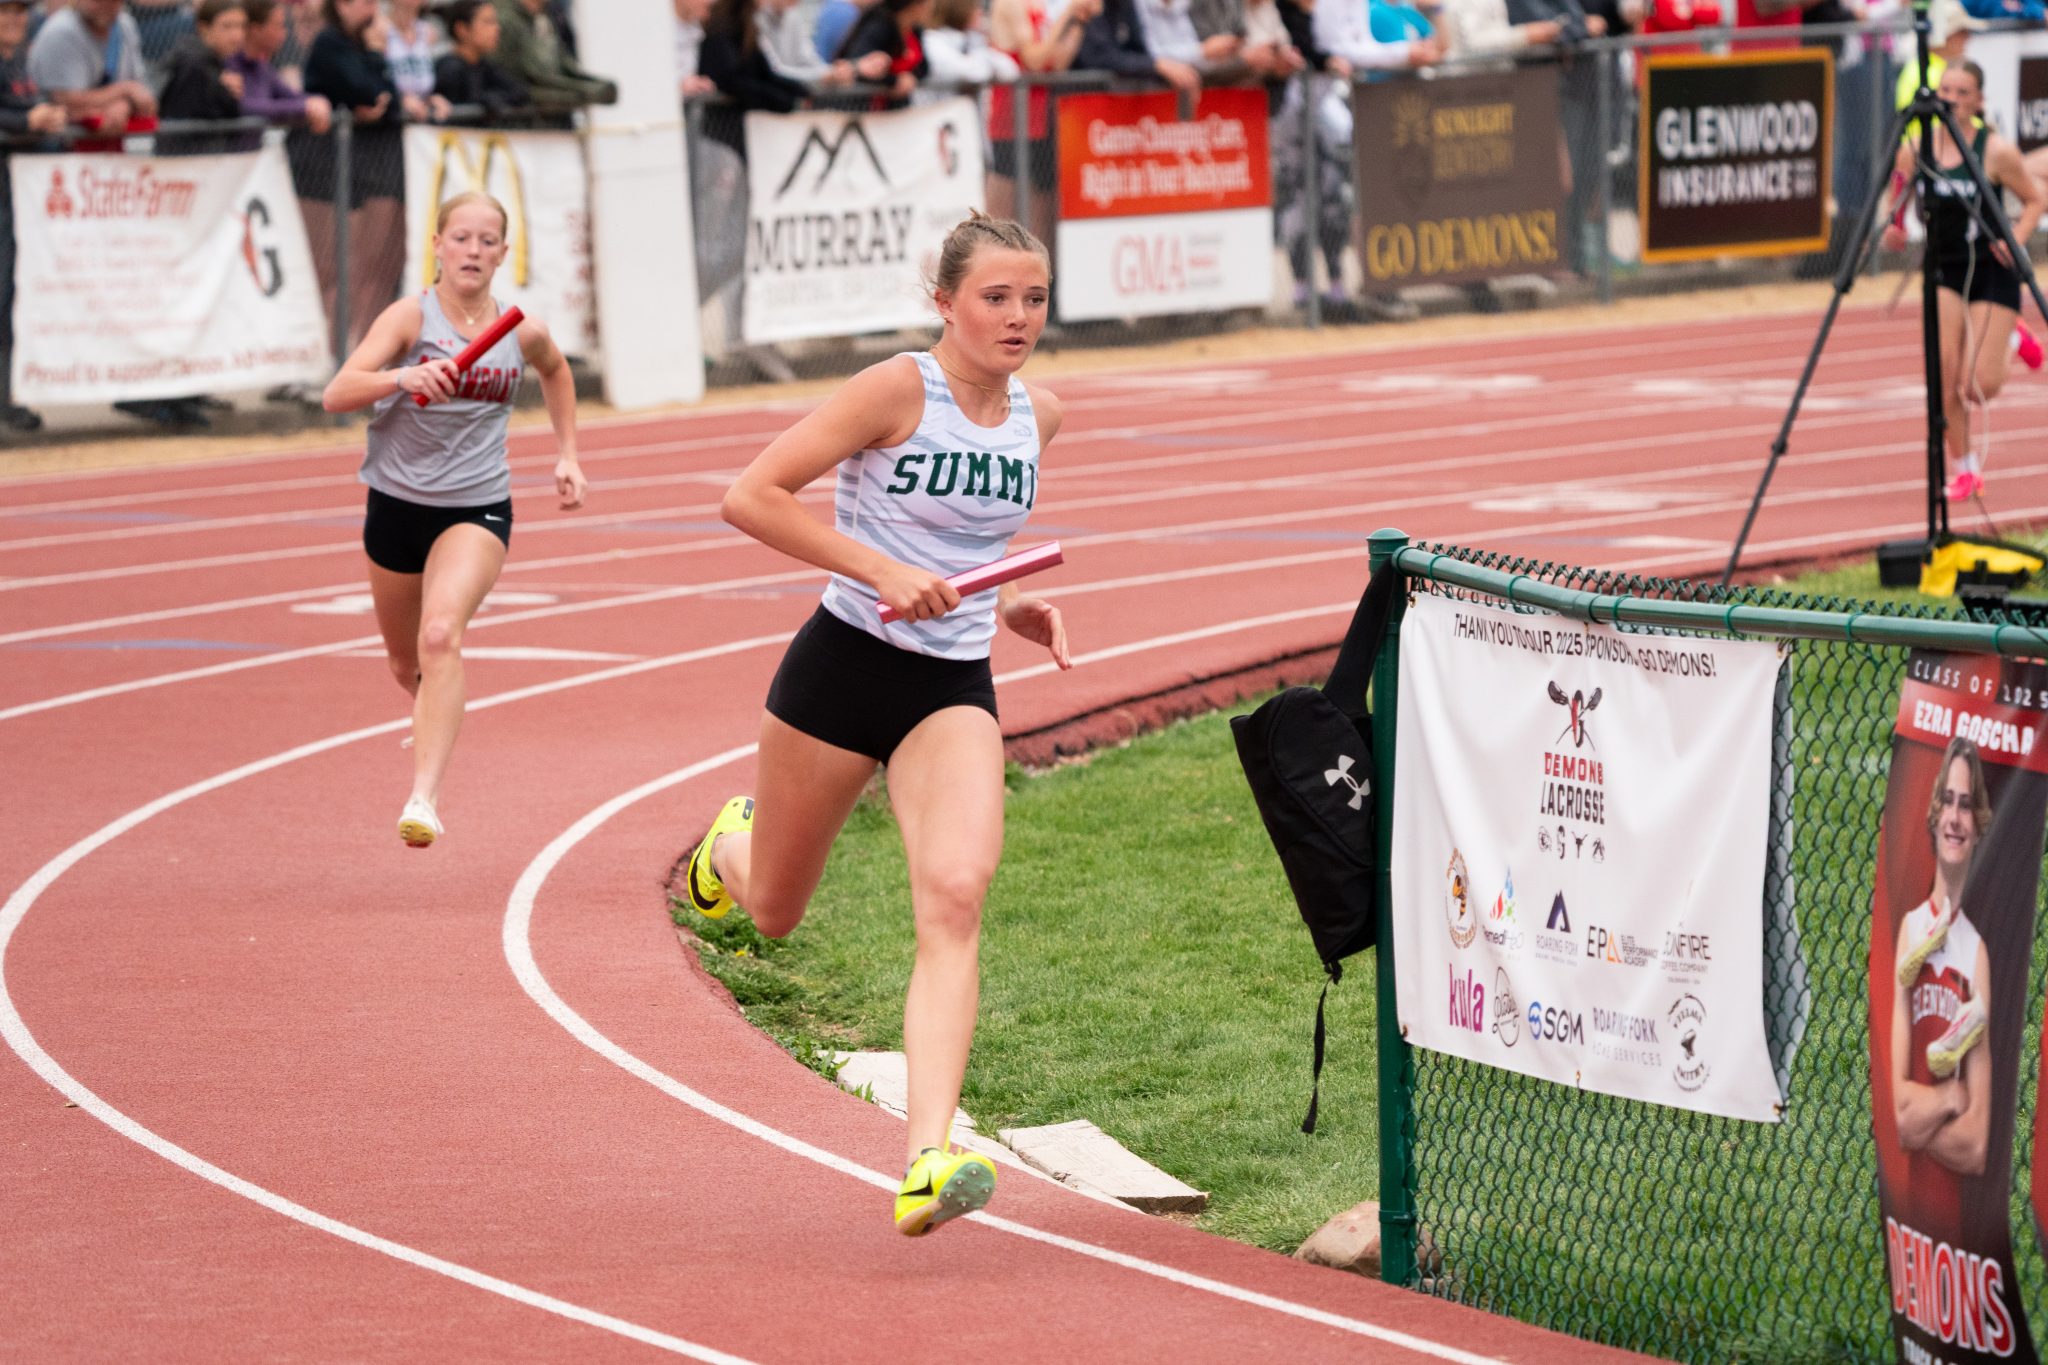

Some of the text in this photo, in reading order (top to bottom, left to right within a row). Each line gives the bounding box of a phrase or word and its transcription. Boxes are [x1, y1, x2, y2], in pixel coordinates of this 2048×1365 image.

[1656, 100, 1818, 160] GLENWOOD
[1659, 160, 1793, 208] INSURANCE
[750, 204, 914, 274] MURRAY
[1111, 234, 1186, 296] GMA
[1366, 209, 1559, 281] GO DEMONS!
[886, 451, 1039, 510] SUMMI
[1454, 613, 1490, 643] THANK
[1488, 620, 1513, 646] YOU
[1512, 625, 1528, 649] TO
[1524, 629, 1554, 654] OUR
[1556, 631, 1583, 656] 2025
[1638, 647, 1658, 672] GO
[1657, 649, 1717, 677] DEMONS!
[1913, 659, 1960, 689] CLASS
[1970, 675, 1993, 697] OF
[1912, 699, 1953, 737] EZRA
[1544, 751, 1603, 785] DEMONS
[1540, 780, 1605, 825] LACROSSE
[1449, 963, 1485, 1033] kula
[1543, 1006, 1584, 1045] SGM
[1628, 1016, 1660, 1044] FORK
[1614, 1046, 1662, 1067] SERVICES
[1886, 1216, 2016, 1358] DEMONS
